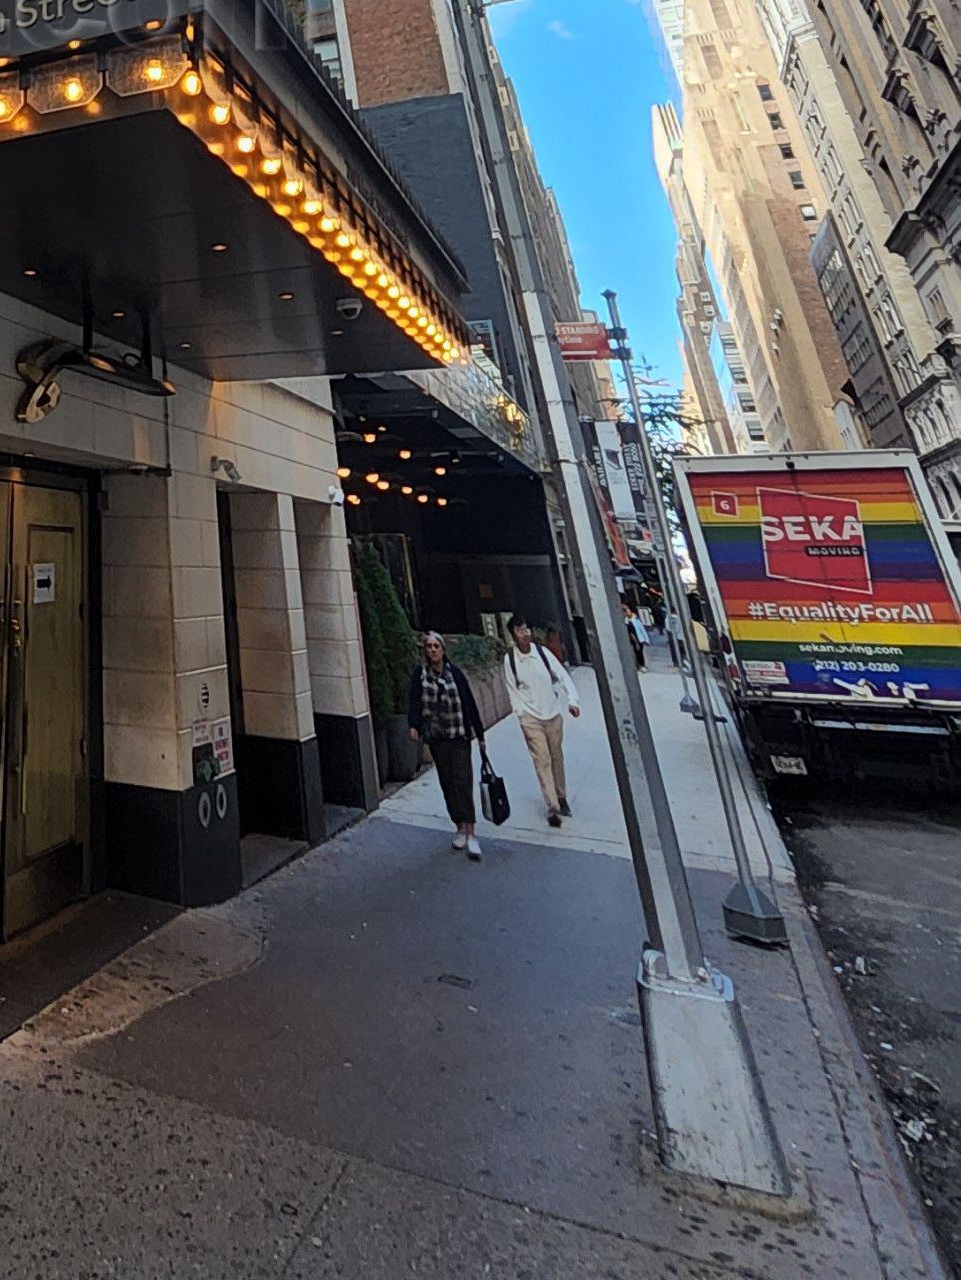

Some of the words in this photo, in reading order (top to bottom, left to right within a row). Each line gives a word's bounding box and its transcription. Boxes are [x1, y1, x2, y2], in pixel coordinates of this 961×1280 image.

[720, 500, 730, 511] 6
[761, 515, 864, 542] SEKA
[808, 547, 861, 556] MOVING
[748, 601, 935, 626] #EqualityForAll
